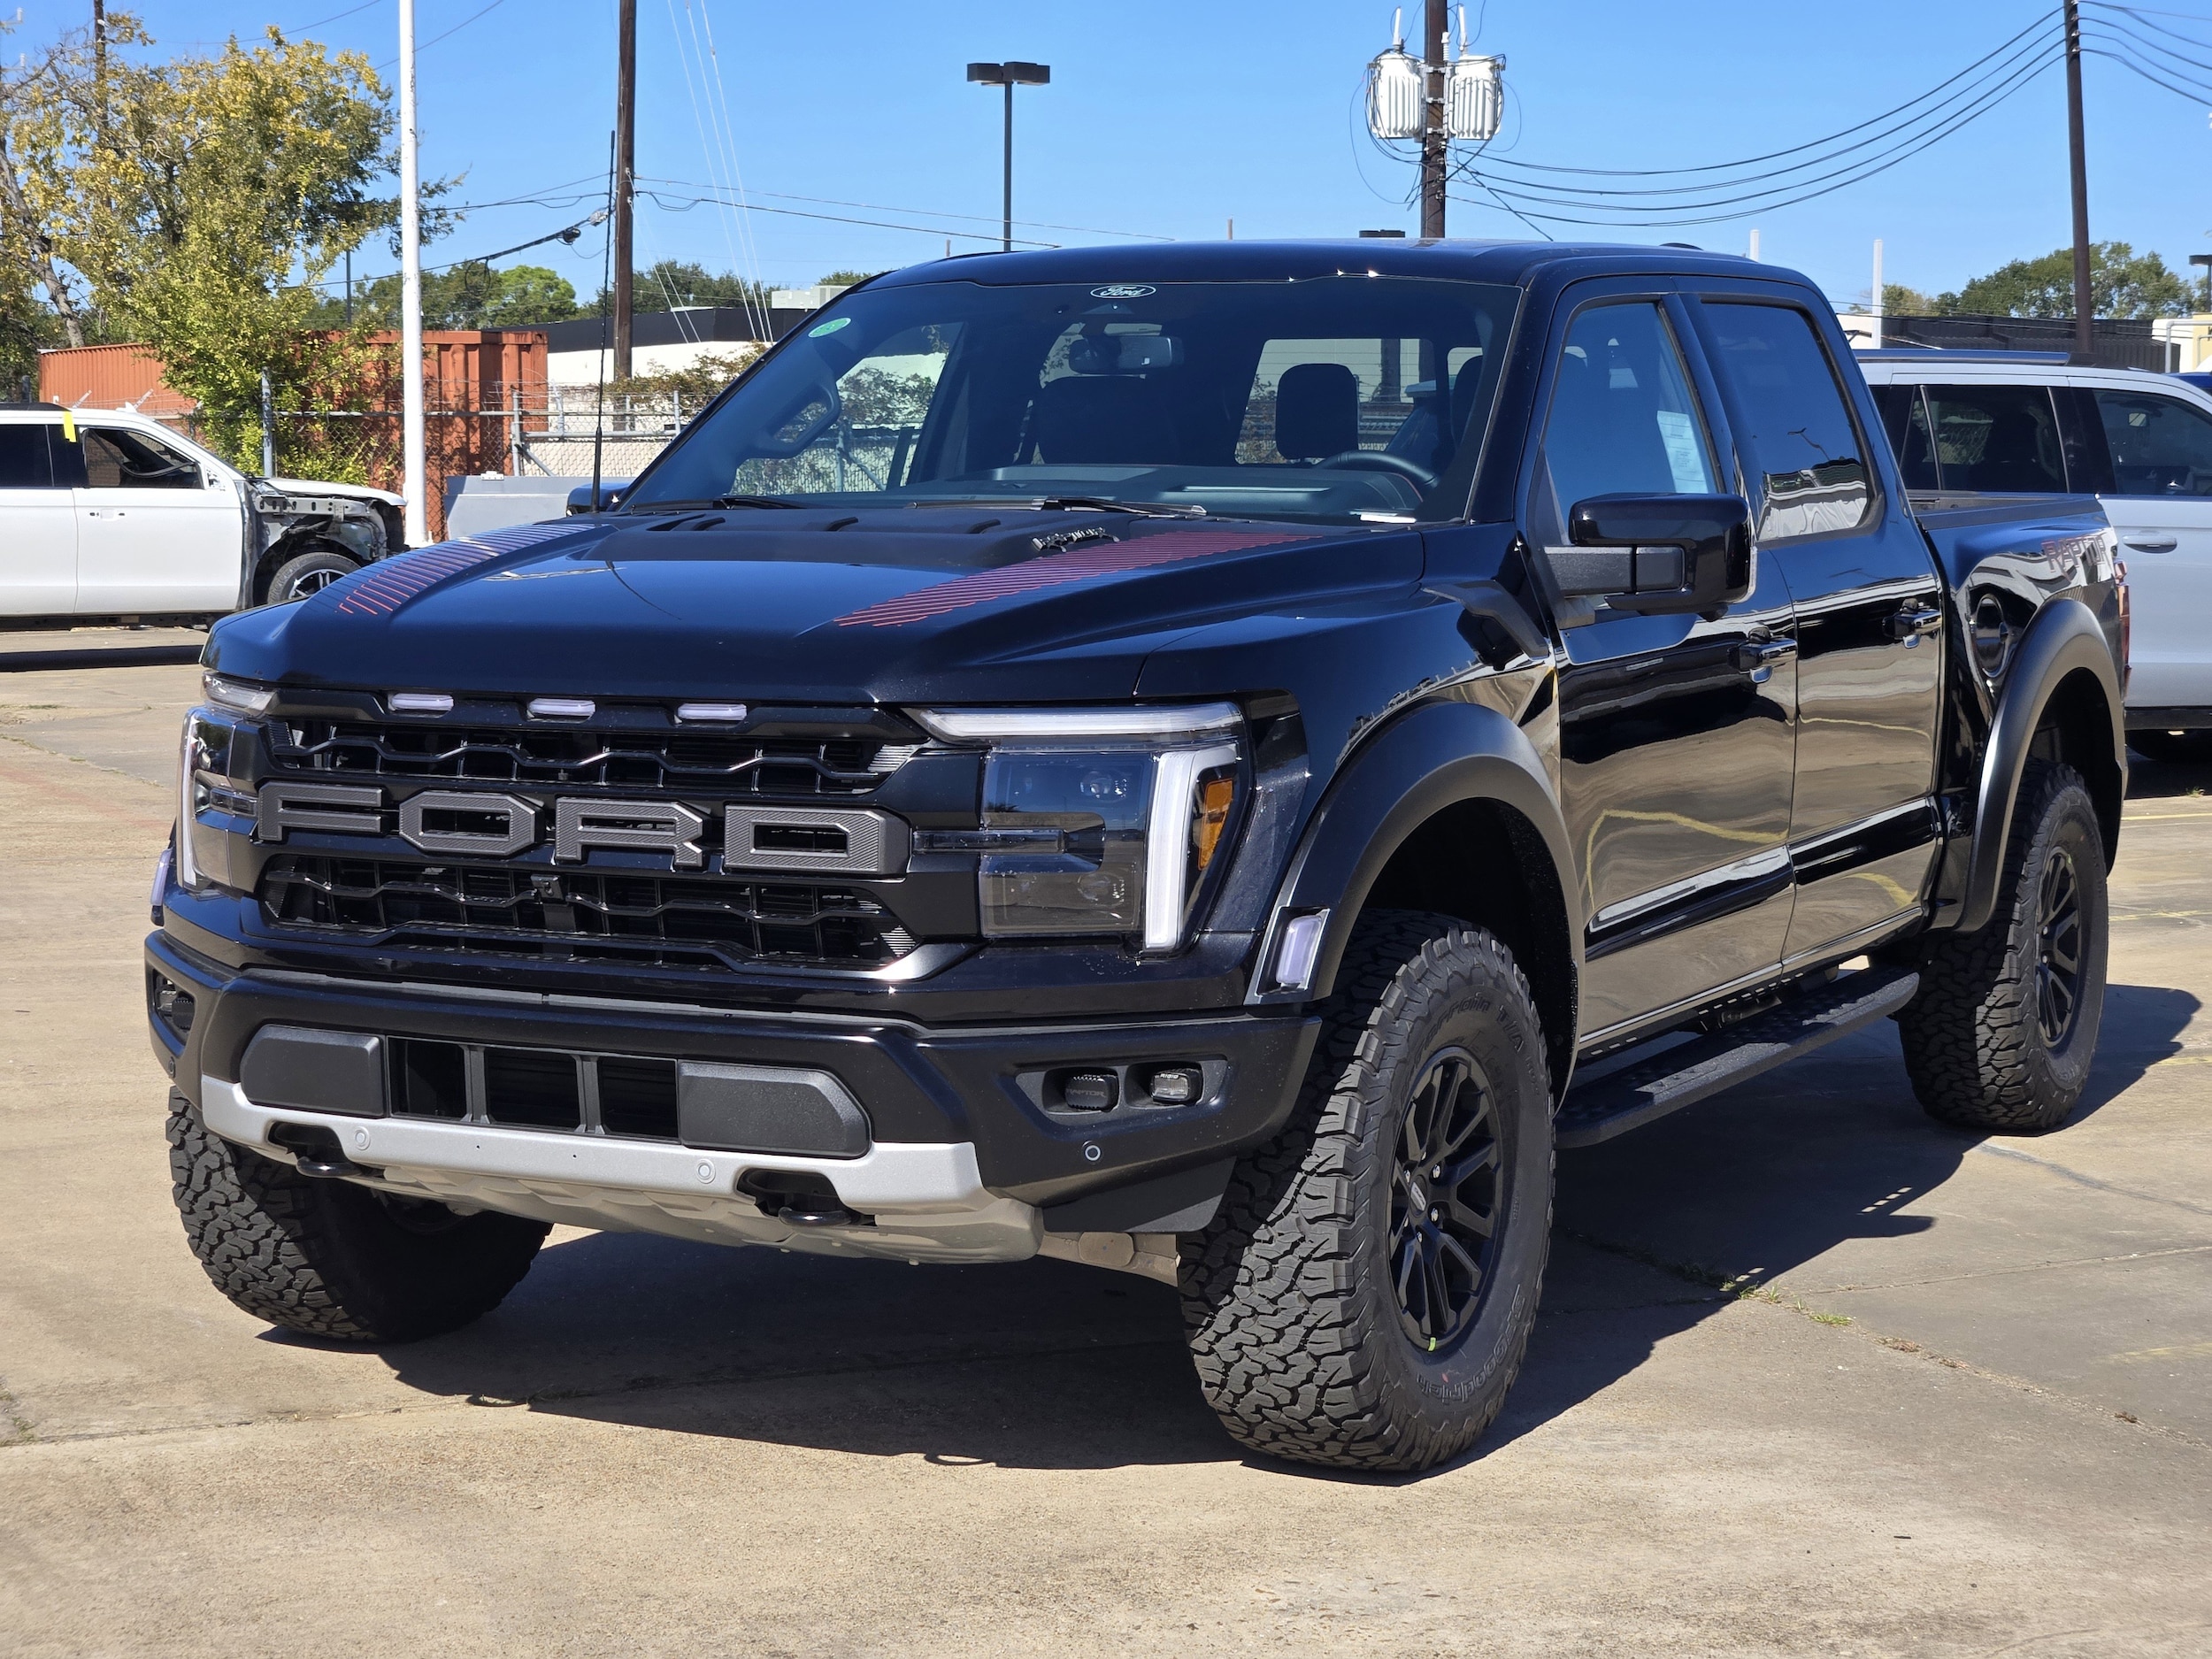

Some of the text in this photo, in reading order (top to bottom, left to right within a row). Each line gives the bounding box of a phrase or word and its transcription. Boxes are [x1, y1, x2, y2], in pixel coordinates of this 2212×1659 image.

[1100, 285, 1147, 297] Ford
[2041, 535, 2112, 582] RAPTOR
[257, 781, 889, 873] FORD
